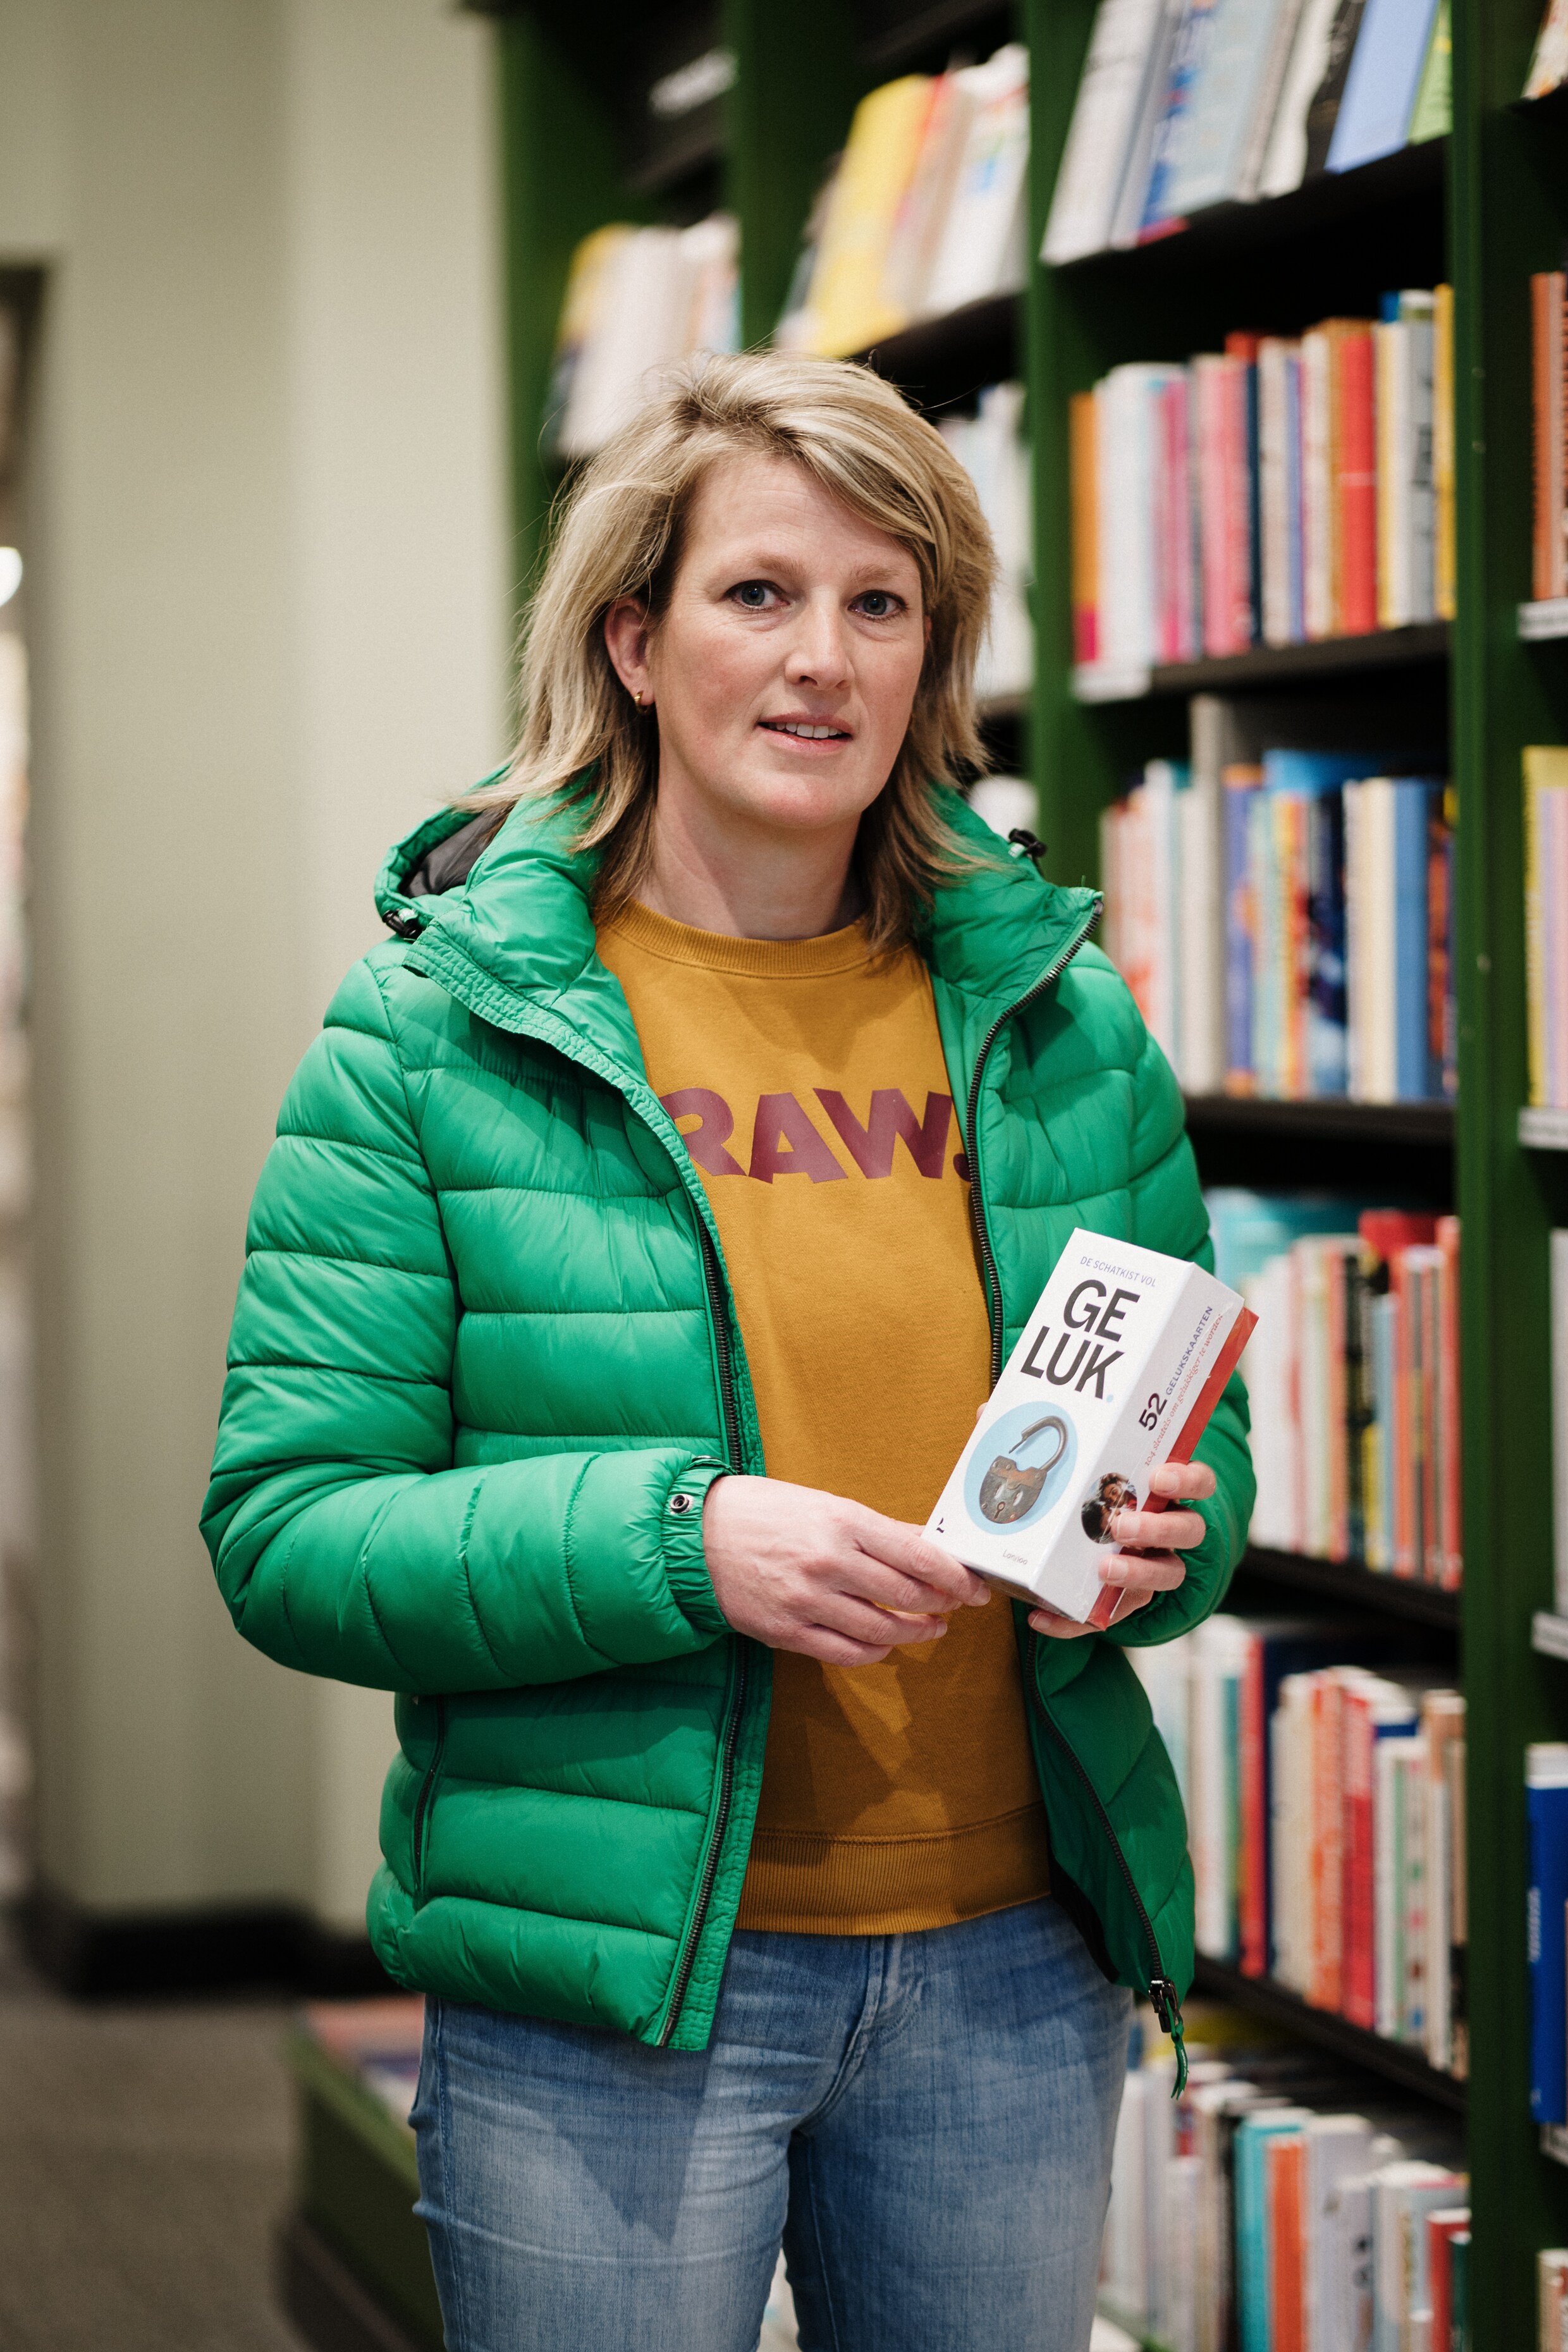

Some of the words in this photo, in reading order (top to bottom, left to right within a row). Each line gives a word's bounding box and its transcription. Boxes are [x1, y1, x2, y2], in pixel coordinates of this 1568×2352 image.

[1063, 1279, 1141, 1342] GE
[1080, 1256, 1093, 1267] DE
[1093, 1260, 1140, 1282] SCHATKIST
[1141, 1275, 1156, 1287] VOL
[1139, 1392, 1168, 1431] 52
[1165, 1306, 1213, 1395] GELUKSKAARTEN
[1144, 1451, 1156, 1466] 104
[1153, 1418, 1172, 1450] sleutels
[1170, 1402, 1179, 1418] om
[1177, 1356, 1201, 1404] gelukkiger
[1199, 1347, 1206, 1357] te
